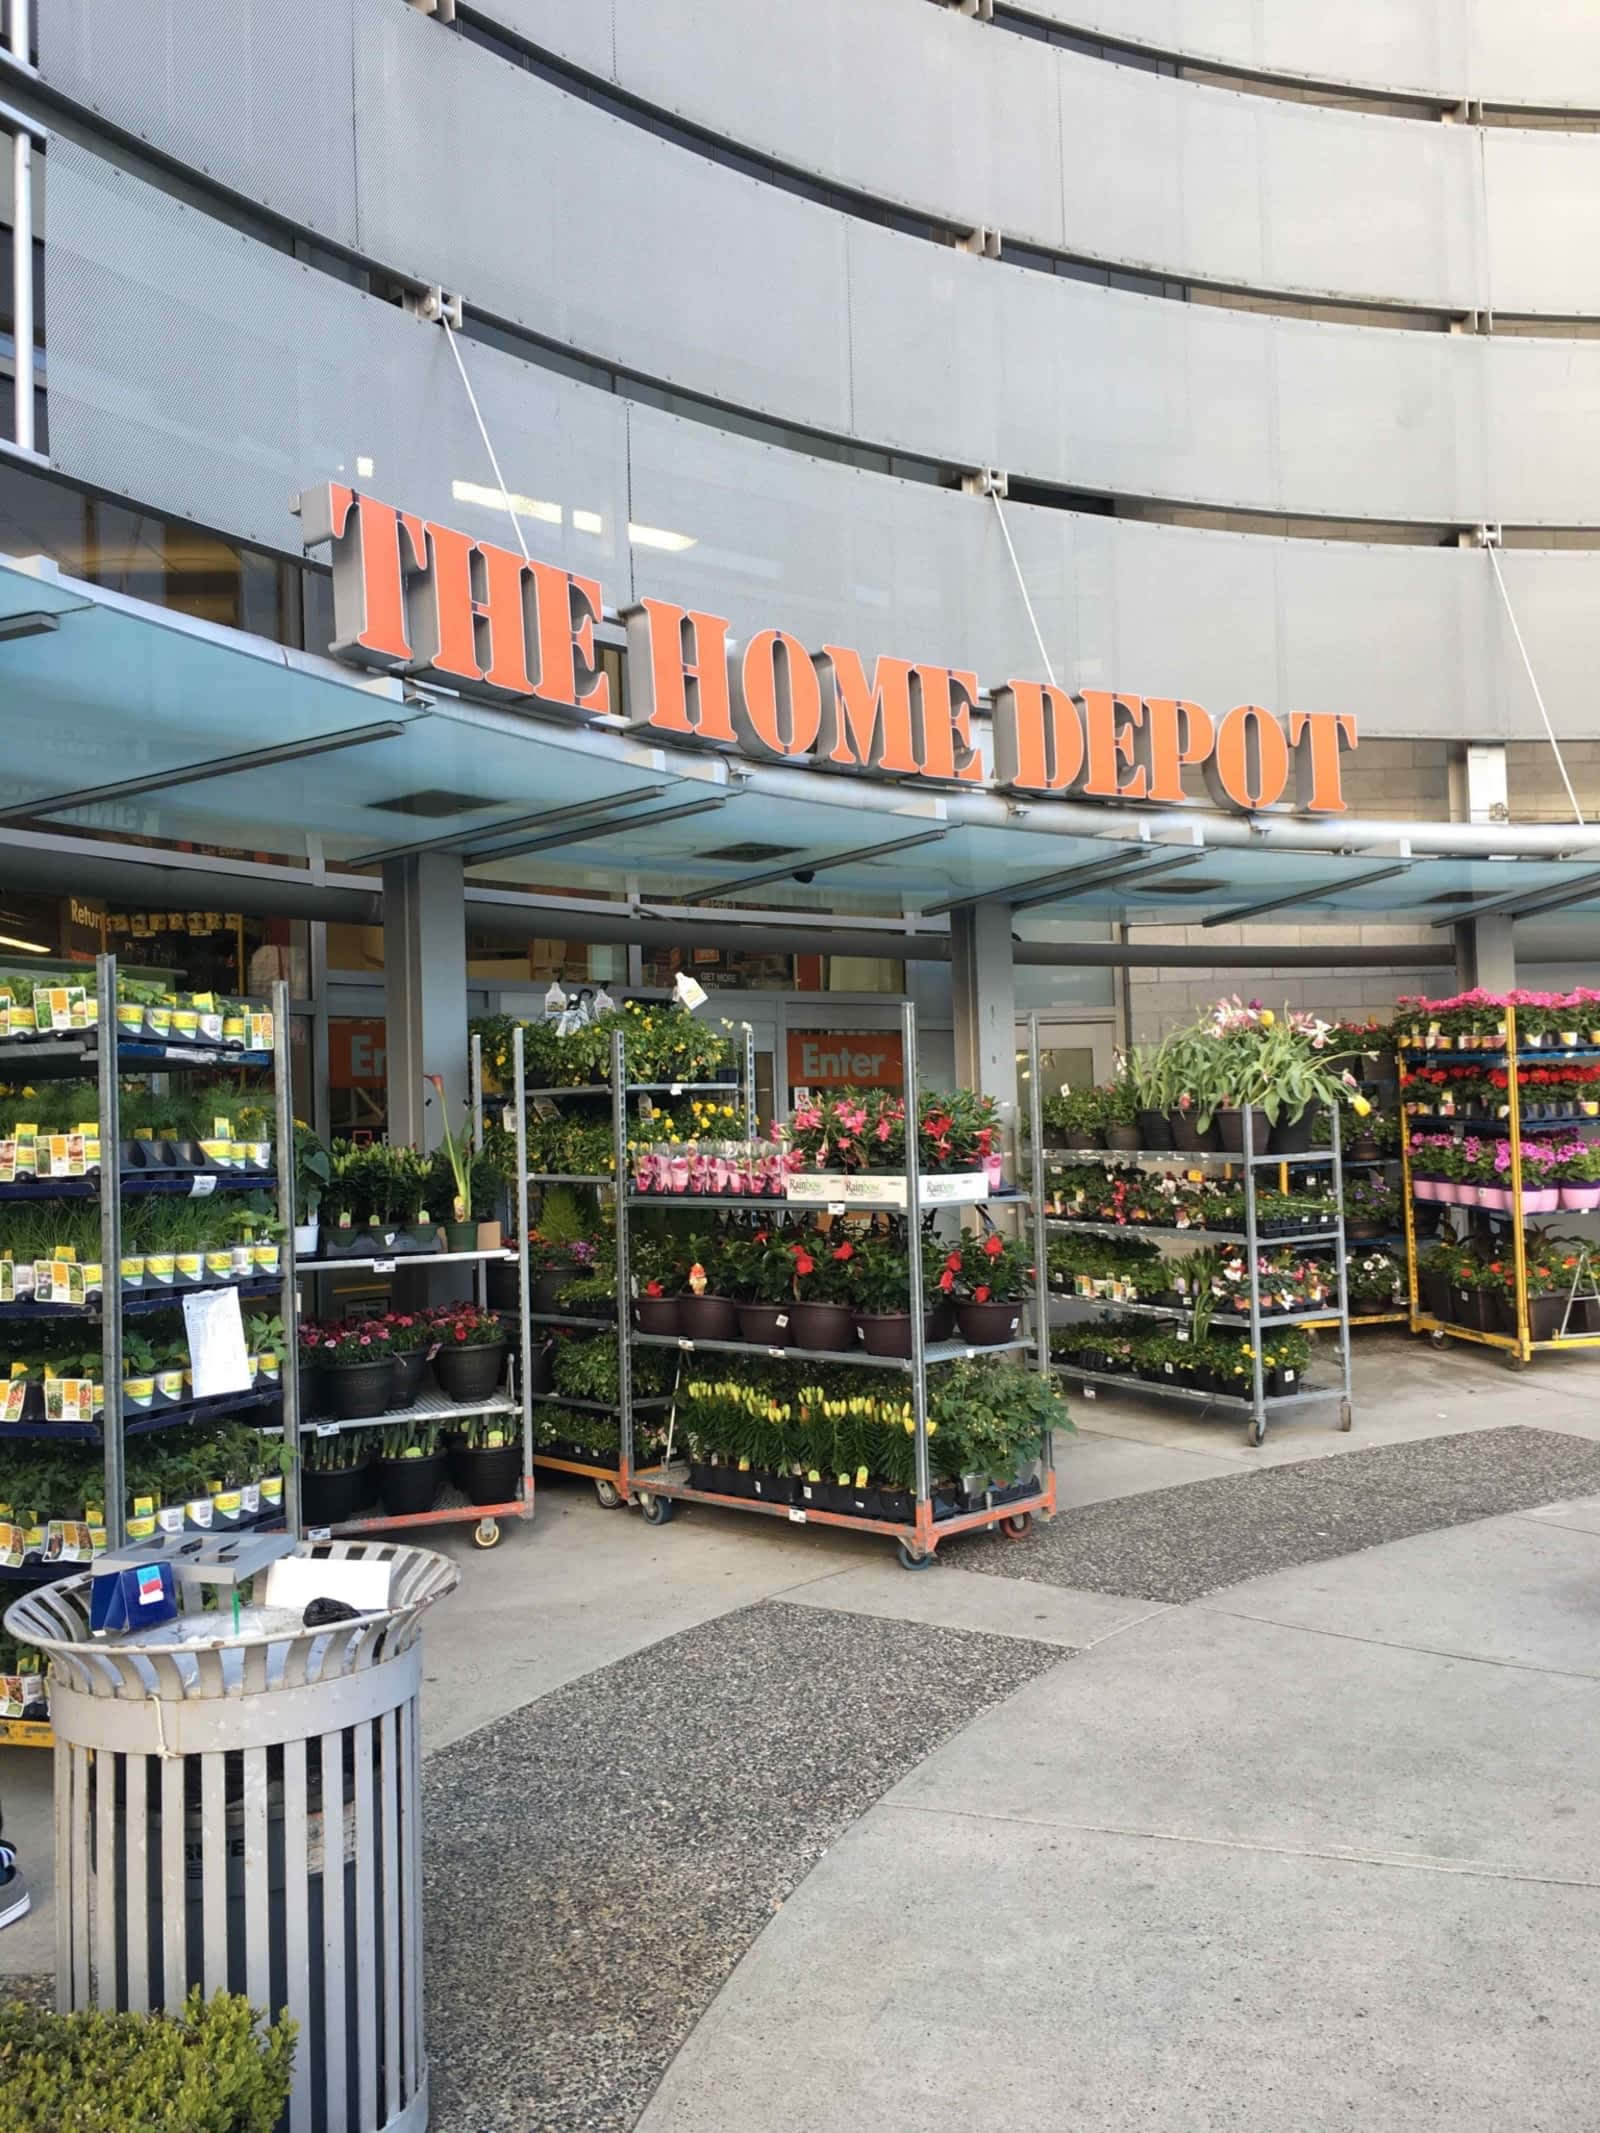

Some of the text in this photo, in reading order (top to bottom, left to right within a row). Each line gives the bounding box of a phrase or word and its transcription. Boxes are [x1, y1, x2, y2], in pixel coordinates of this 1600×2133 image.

[328, 481, 1358, 812] THE HOME DEPOT
[802, 1043, 887, 1078] Enter
